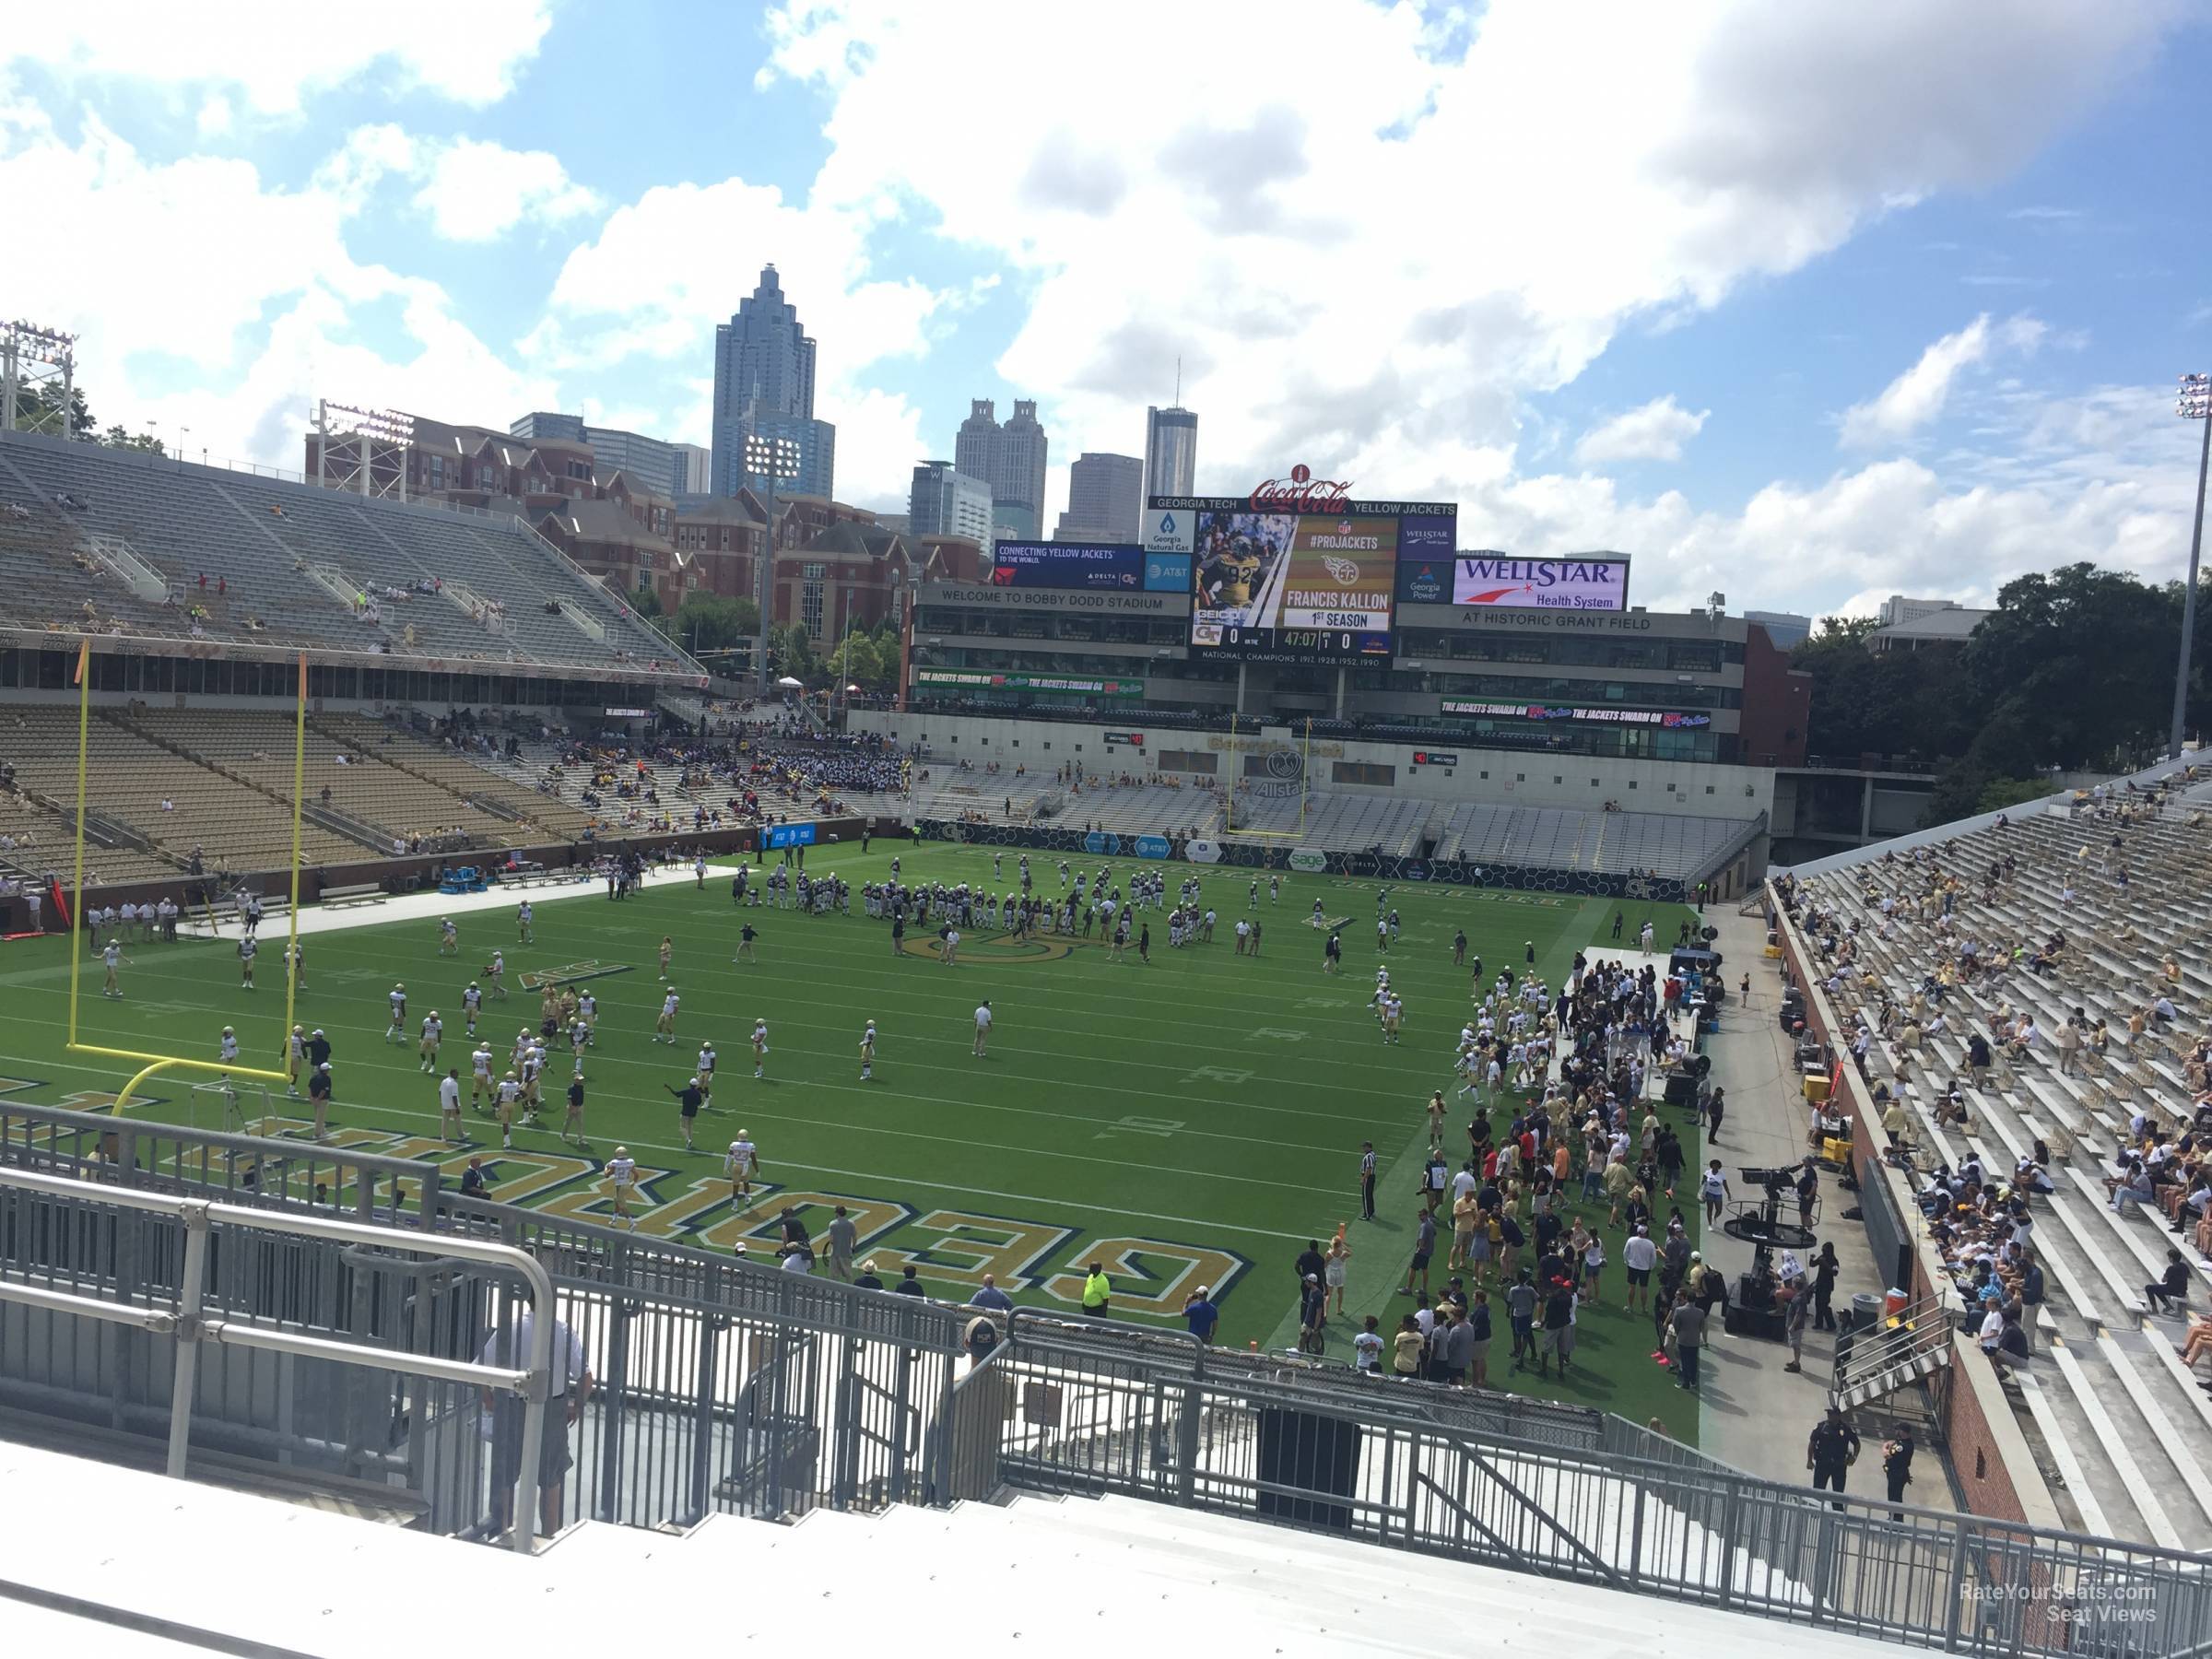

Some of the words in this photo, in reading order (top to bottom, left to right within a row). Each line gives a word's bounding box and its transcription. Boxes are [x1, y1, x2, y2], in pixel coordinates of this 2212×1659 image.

[930, 471, 940, 479] W
[1249, 478, 1355, 512] Coca-Cola
[1157, 498, 1206, 510] GEORGIA
[1208, 499, 1237, 510] TECH
[1354, 502, 1402, 513] YELLOW
[1403, 503, 1455, 515] JACKETS
[1153, 535, 1182, 545] Georgia
[1310, 535, 1378, 549] #PROJACKETS
[999, 546, 1047, 557] CONNECTING
[1048, 547, 1079, 559] YELLOW
[1147, 543, 1173, 551] Natural
[1175, 544, 1189, 552] Gas
[1163, 567, 1188, 577] AT&T
[1465, 559, 1610, 587] WELLSTAR
[1410, 582, 1441, 593] Georgia
[942, 590, 1002, 604] WELCOME
[1005, 593, 1021, 603] TO
[1025, 594, 1066, 606] BOBBY
[1069, 595, 1104, 607] DODD
[1108, 597, 1163, 609] STADIUM
[1287, 590, 1338, 608] FRANCIS
[1340, 592, 1388, 610] KALLON
[1413, 591, 1438, 600] Power
[1536, 594, 1571, 606] Health
[1573, 595, 1613, 609] System
[1197, 609, 1240, 620] GEICO
[1326, 613, 1368, 627] SEASON
[1463, 612, 1480, 623] AT
[1484, 613, 1550, 627] HISTORIC
[1556, 615, 1604, 628] GRANT
[1609, 618, 1650, 629] FIELD
[1230, 628, 1239, 644] 0
[1284, 631, 1317, 646] 47:07
[1341, 633, 1350, 650] 0
[1202, 651, 1241, 661] NATIONAL
[1246, 653, 1295, 663] CHAMPIONS
[1360, 658, 1380, 667] 1990
[919, 672, 931, 681] THE
[931, 673, 957, 683] JACKETS
[957, 674, 982, 684] SWARM
[982, 676, 992, 684] ON
[1029, 677, 1040, 688] THE
[1041, 678, 1067, 689] JACKETS
[1067, 680, 1092, 690] SWARM
[1093, 682, 1103, 691] ON
[1441, 700, 1455, 712] THE
[1455, 702, 1487, 714] JACKETS
[1487, 704, 1515, 715] SWARM
[1516, 706, 1527, 715] ON
[1572, 709, 1586, 719] THE
[1586, 710, 1619, 721] JACKETS
[1619, 712, 1650, 723] SWARM
[1650, 712, 1663, 723] ON
[1207, 736, 1289, 758] Georgia
[1297, 741, 1345, 759] Tech
[1148, 844, 1167, 853] AT&T
[1291, 853, 1324, 868] sage
